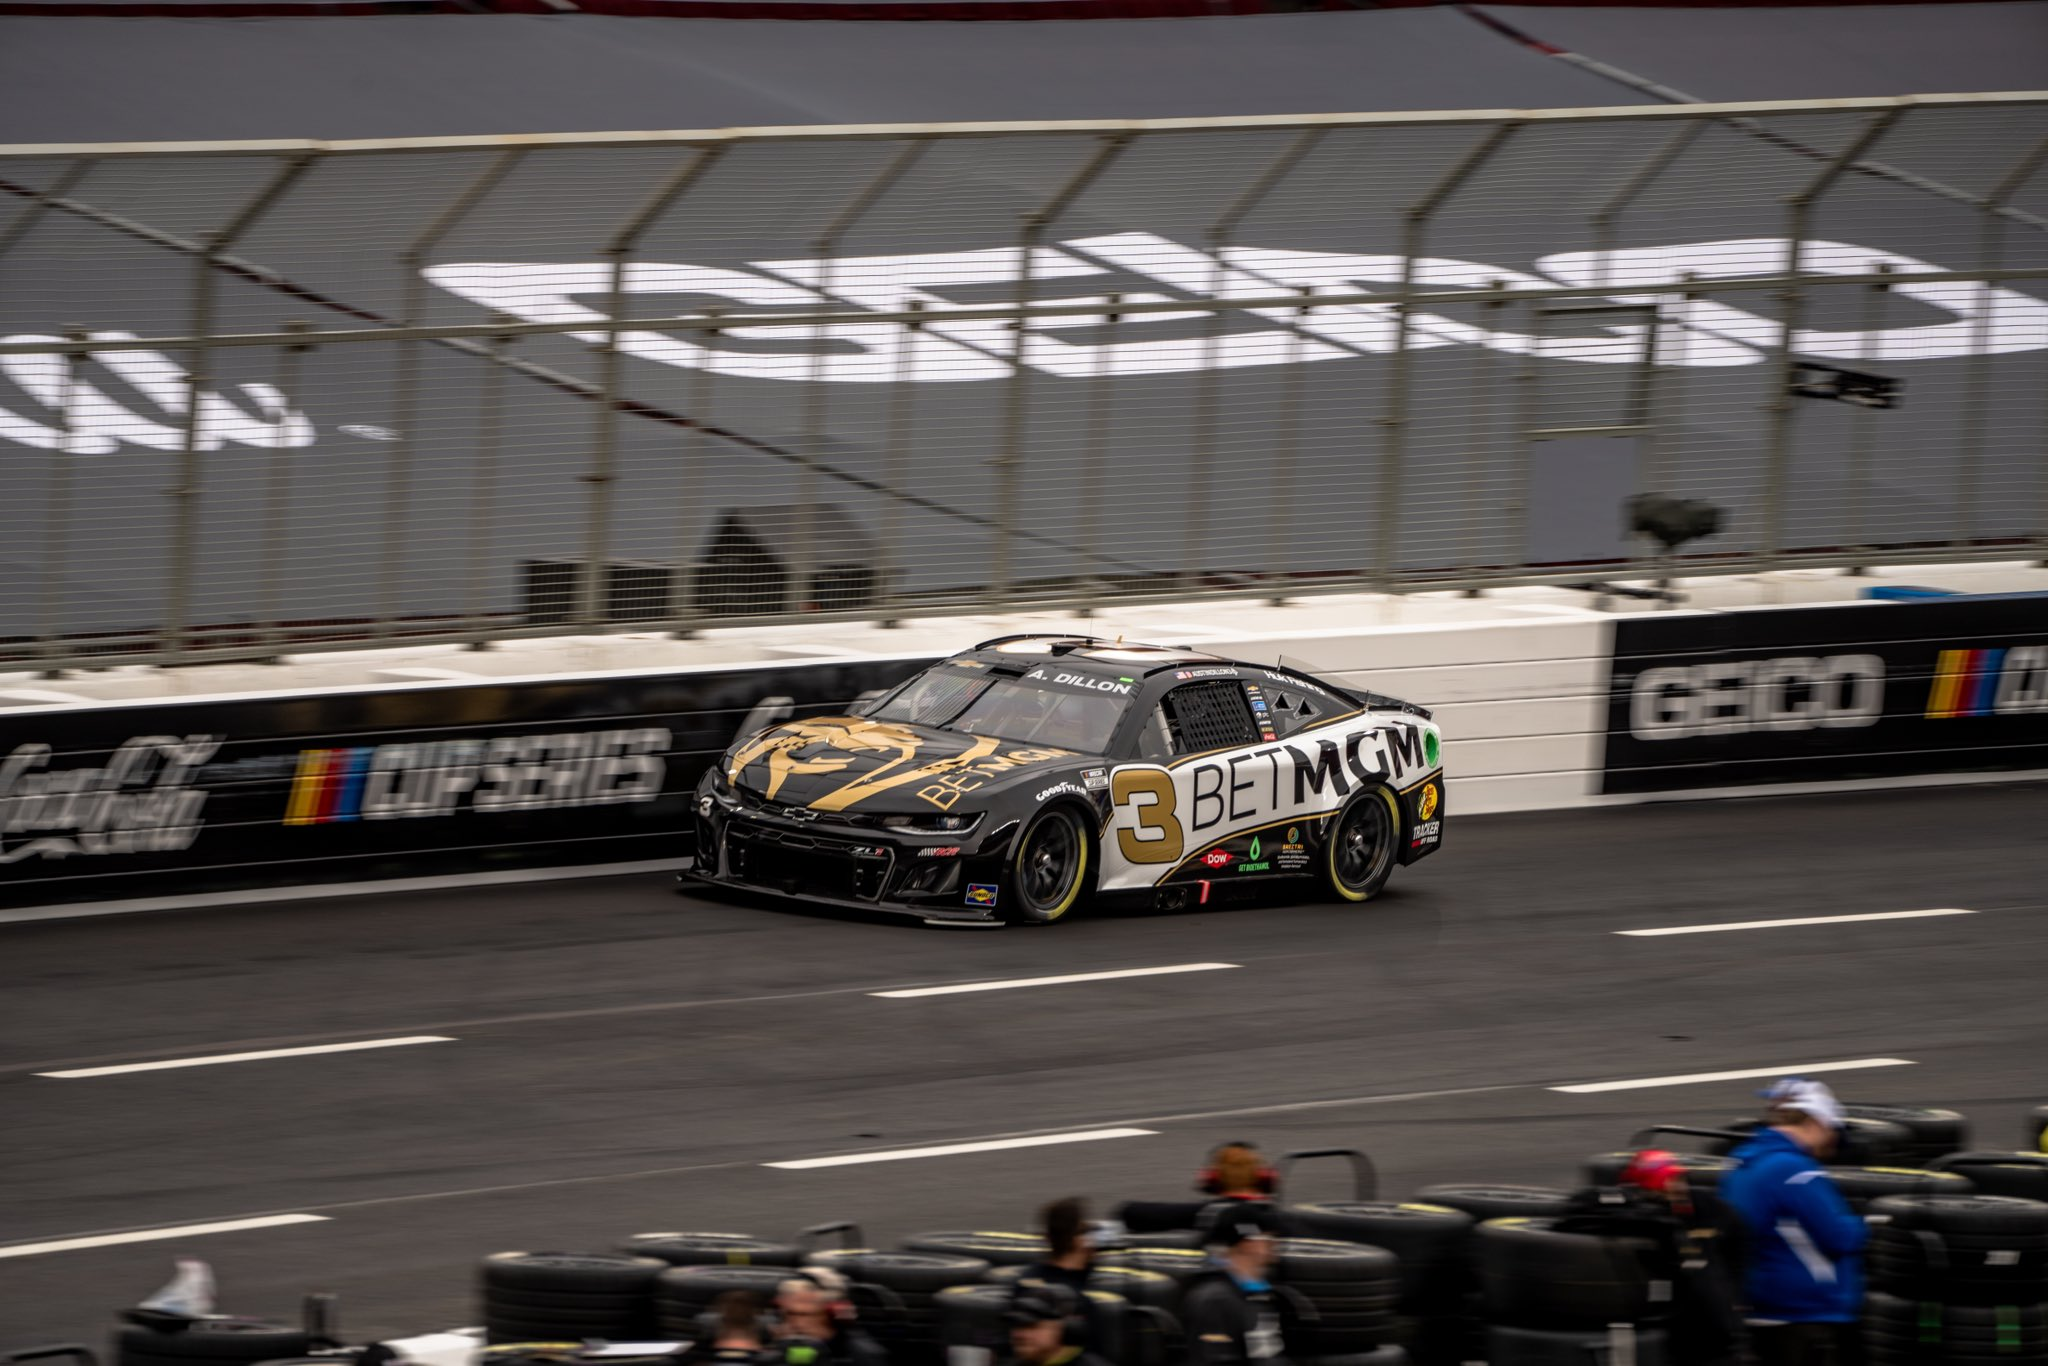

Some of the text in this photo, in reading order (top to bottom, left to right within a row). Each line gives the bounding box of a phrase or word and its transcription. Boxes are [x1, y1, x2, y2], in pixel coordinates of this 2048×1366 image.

[425, 231, 2048, 383] GEICO
[1027, 669, 1131, 695] A. DILLON
[1630, 653, 1886, 741] GEICO
[360, 727, 672, 820] CUP SERIES
[699, 796, 714, 818] 3
[916, 748, 1082, 812] BETMGM
[1035, 782, 1087, 802] GOODYEAR
[1192, 720, 1424, 832] BETMGM
[1112, 768, 1184, 866] 3
[1413, 821, 1440, 840] TRACKER
